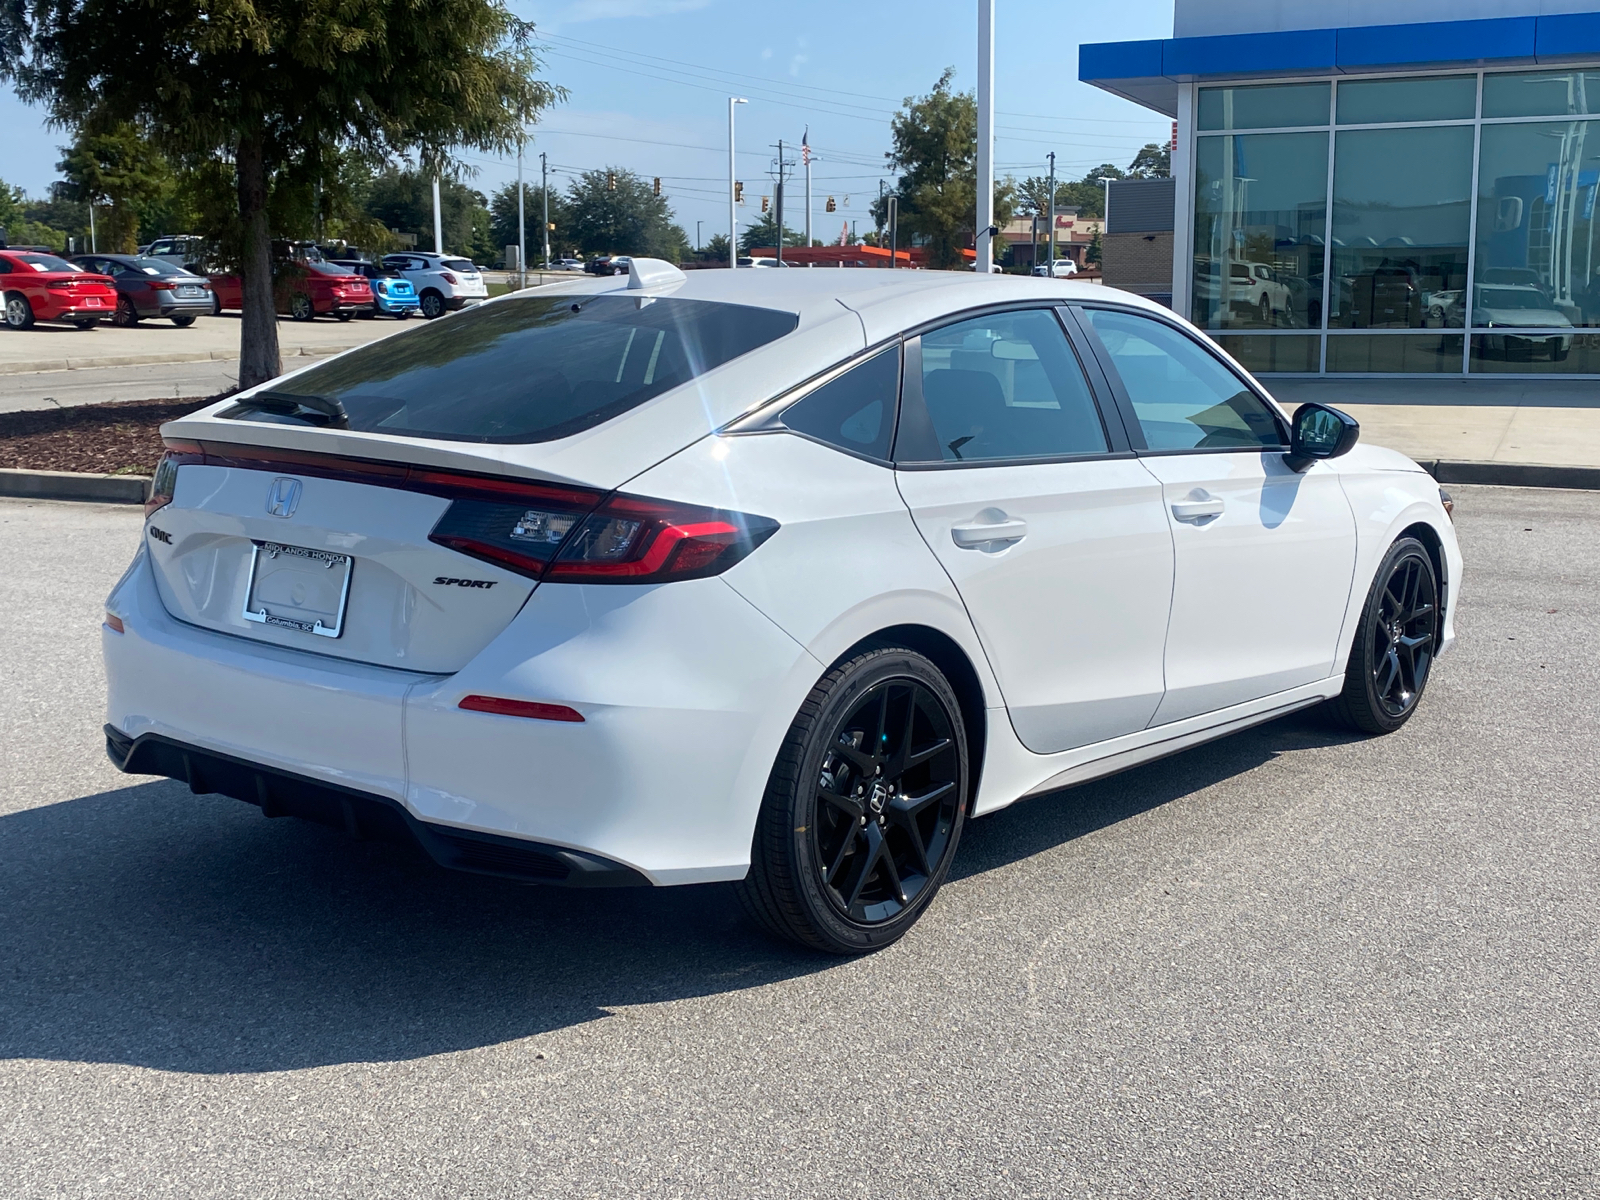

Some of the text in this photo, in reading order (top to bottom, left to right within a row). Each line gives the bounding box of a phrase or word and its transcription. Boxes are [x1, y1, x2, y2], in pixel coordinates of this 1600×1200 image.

[264, 542, 345, 563] MIDLANDS HONDA
[432, 576, 498, 589] SPORT
[301, 623, 313, 631] SC
